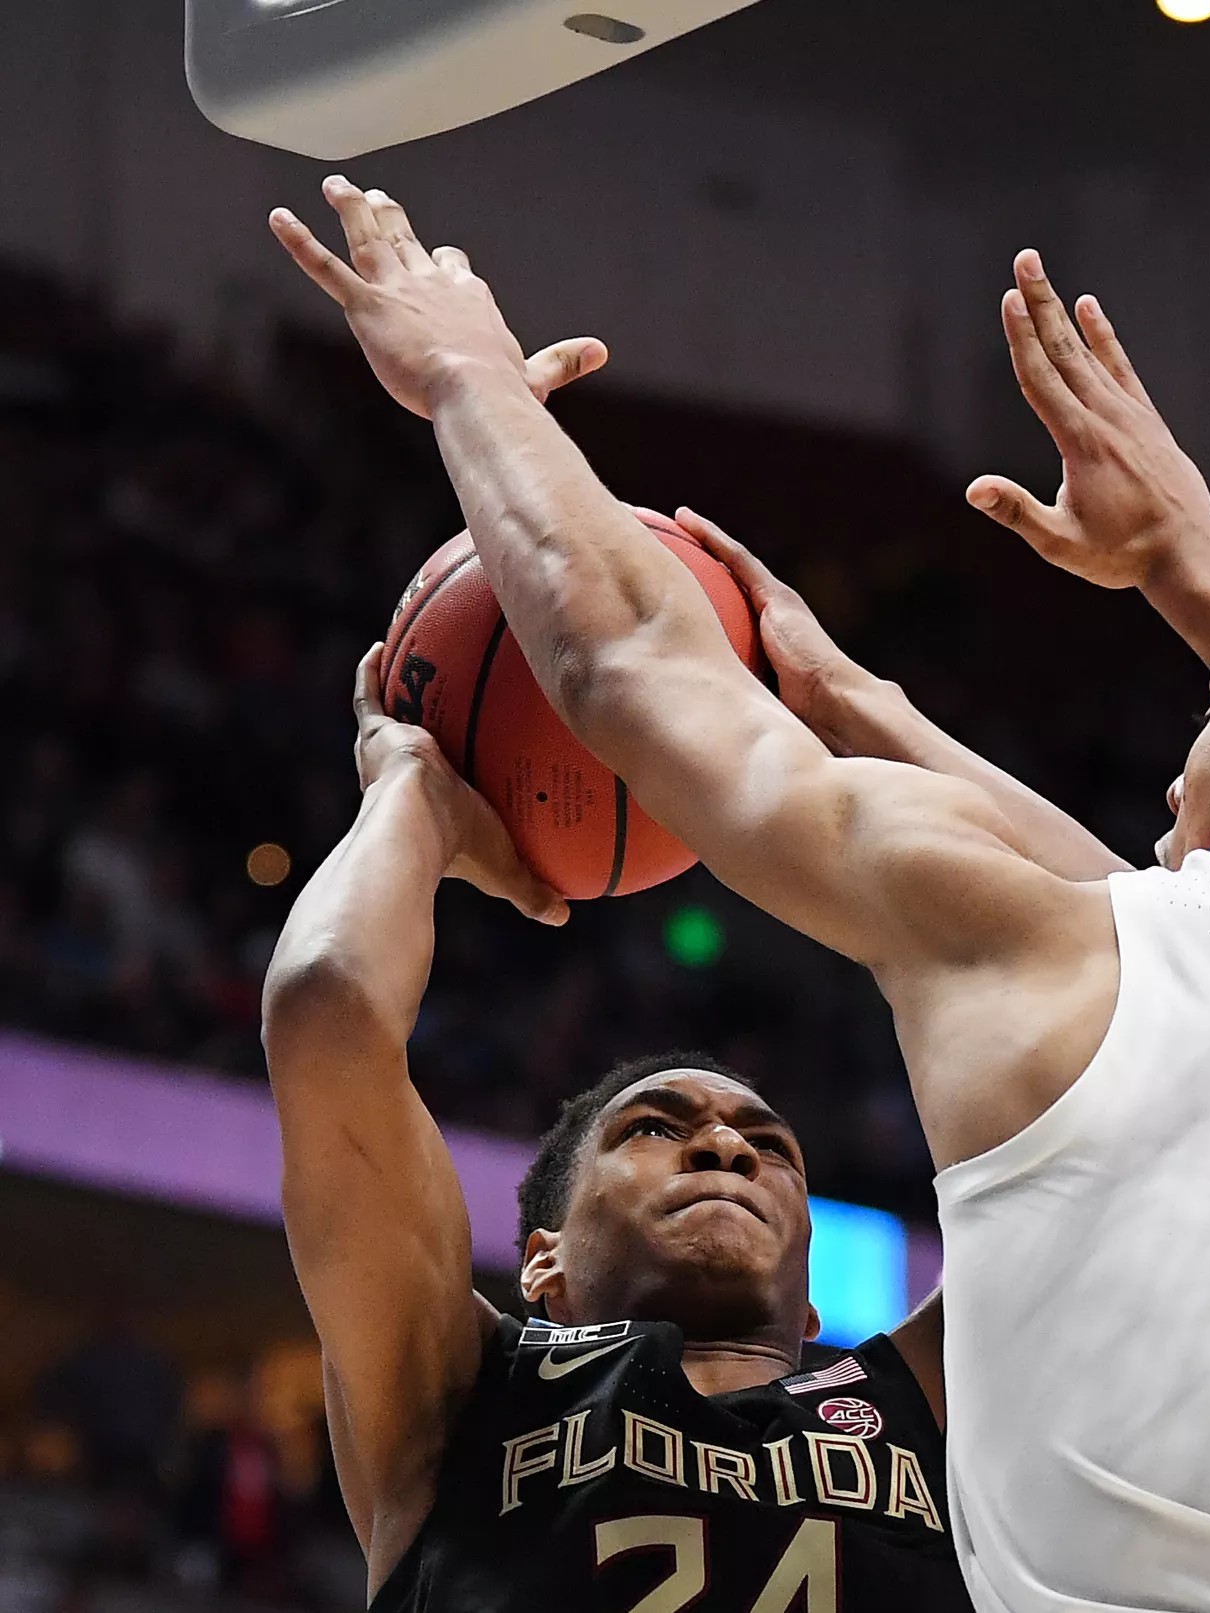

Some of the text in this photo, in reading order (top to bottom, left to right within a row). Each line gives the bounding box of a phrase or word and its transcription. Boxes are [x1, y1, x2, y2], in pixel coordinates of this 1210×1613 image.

[829, 1406, 874, 1420] ACC
[499, 1409, 944, 1533] FLORIDA
[592, 1513, 845, 1613] 24
